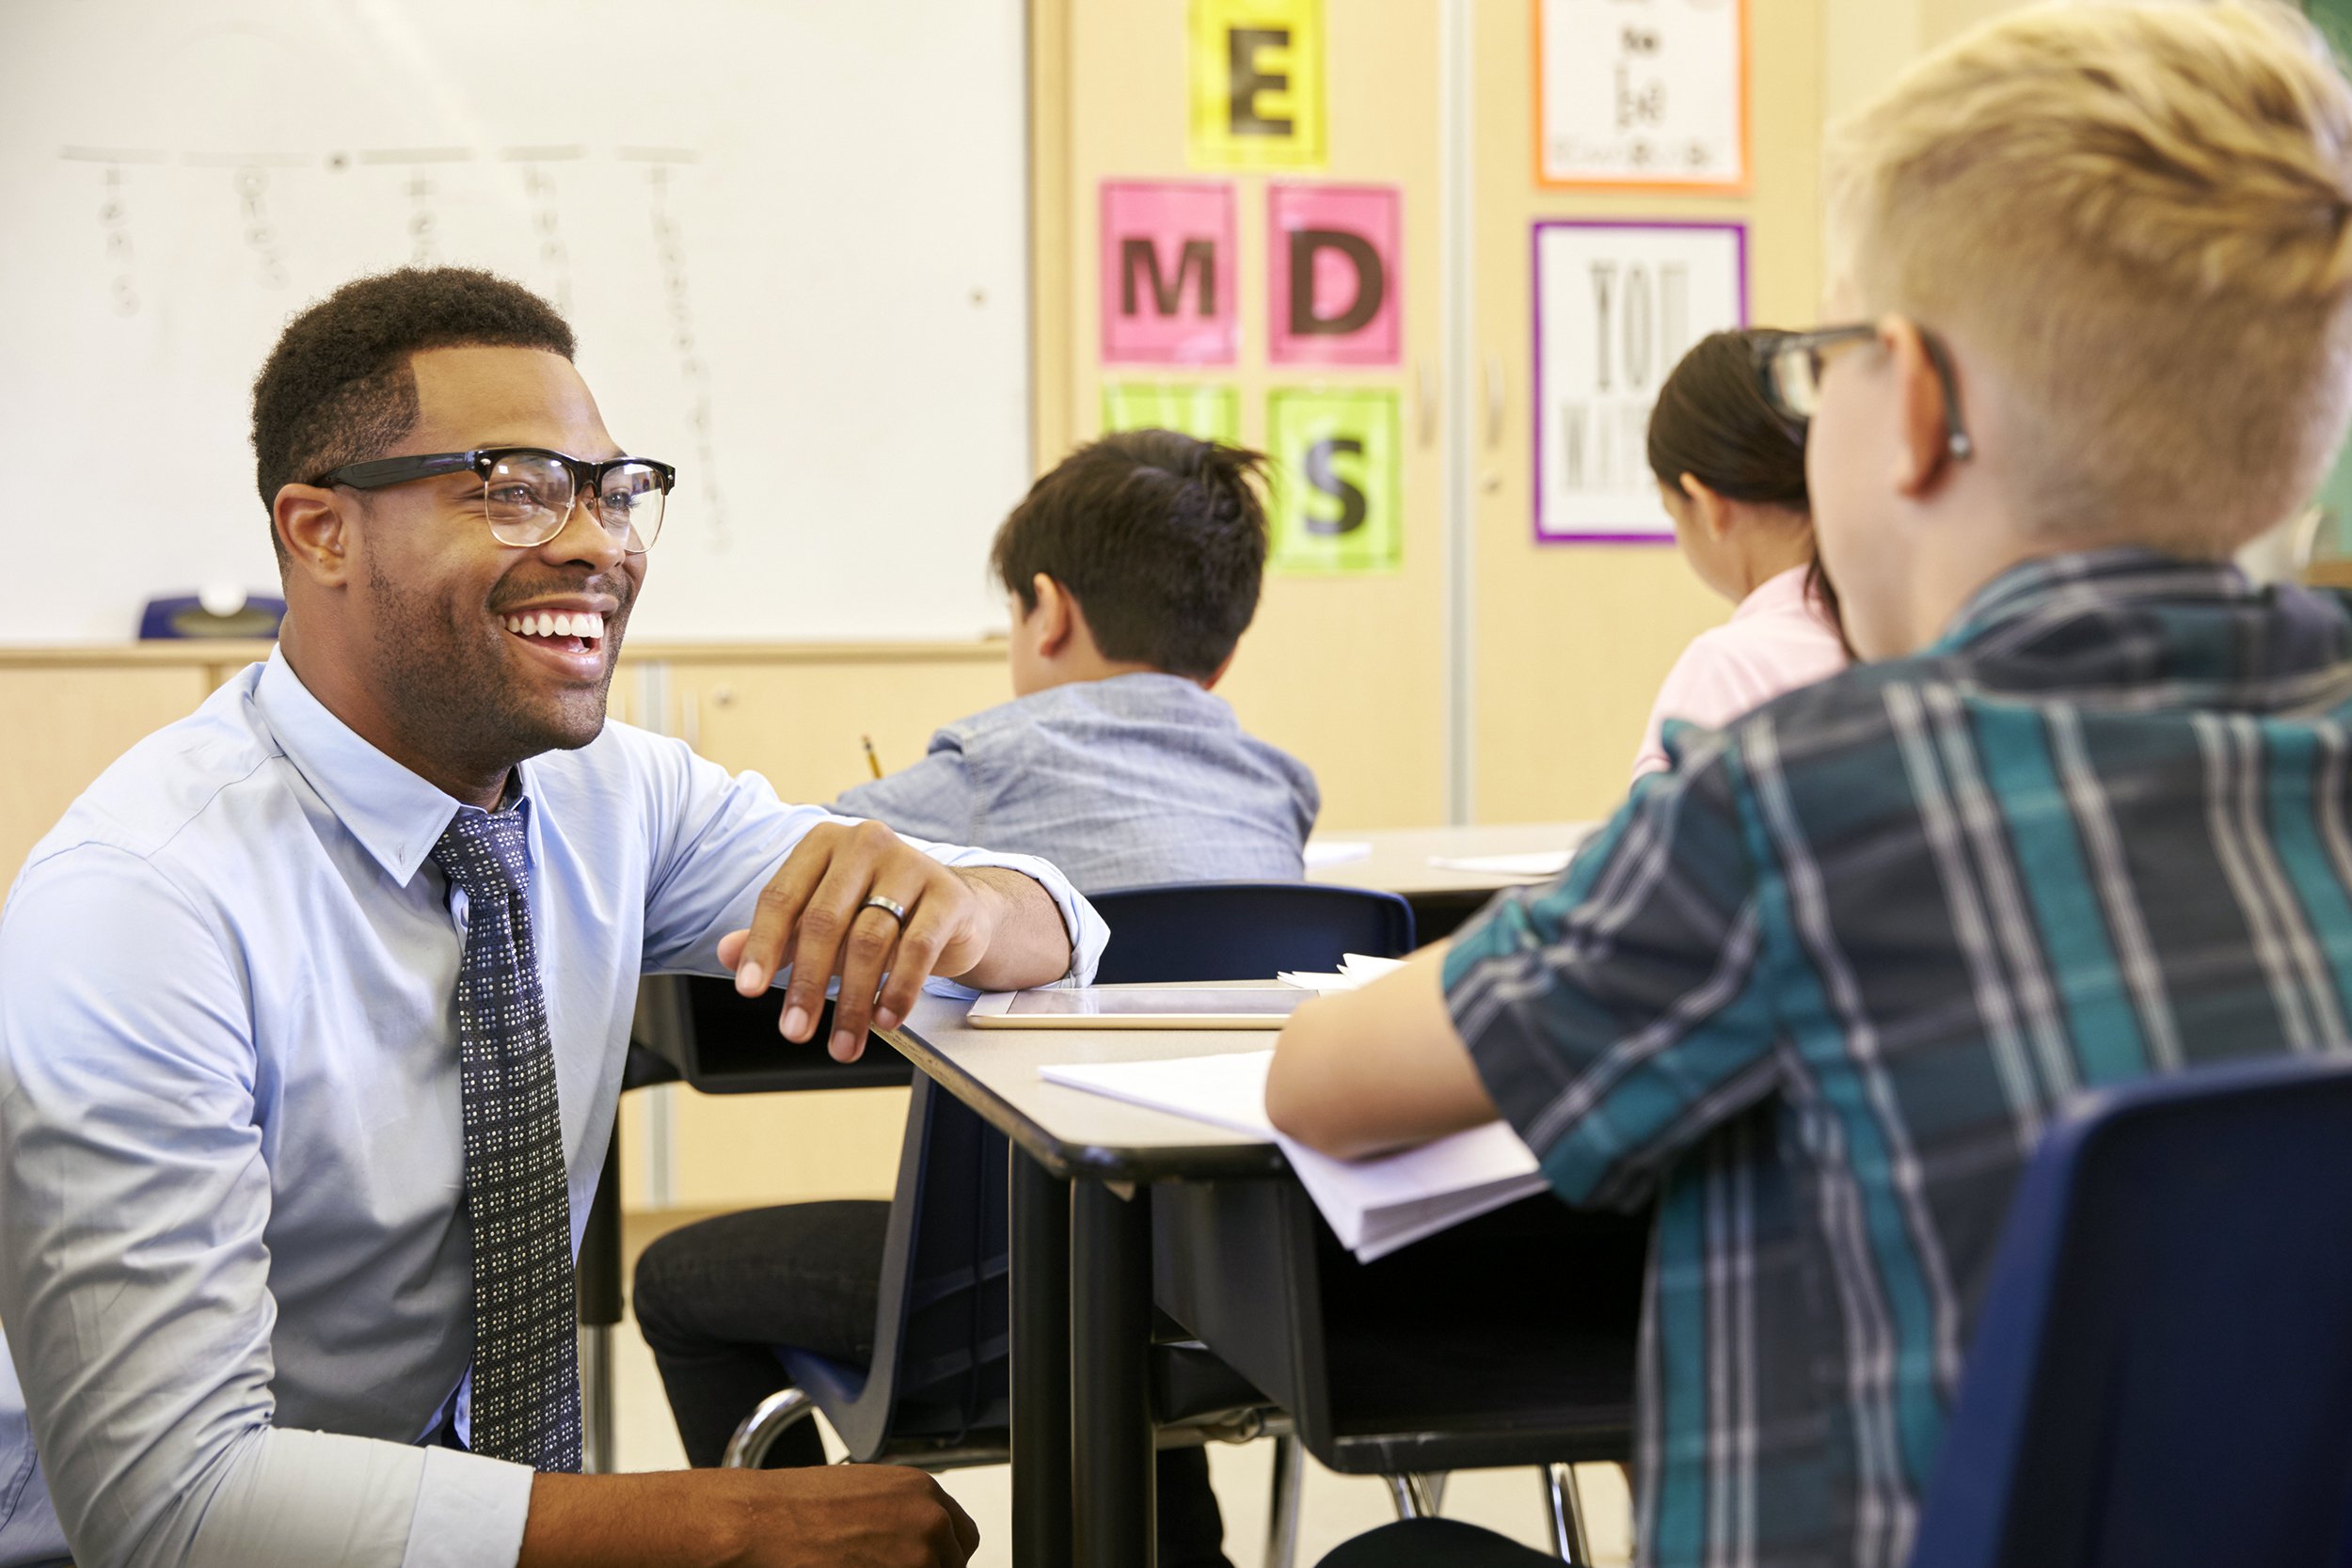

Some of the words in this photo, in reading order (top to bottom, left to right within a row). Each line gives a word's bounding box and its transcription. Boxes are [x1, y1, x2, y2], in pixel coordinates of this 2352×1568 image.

[1228, 28, 1294, 136] E
[1120, 239, 1216, 318] M
[1289, 229, 1386, 337] D
[1589, 261, 1690, 392] YOU
[1305, 438, 1369, 536] S
